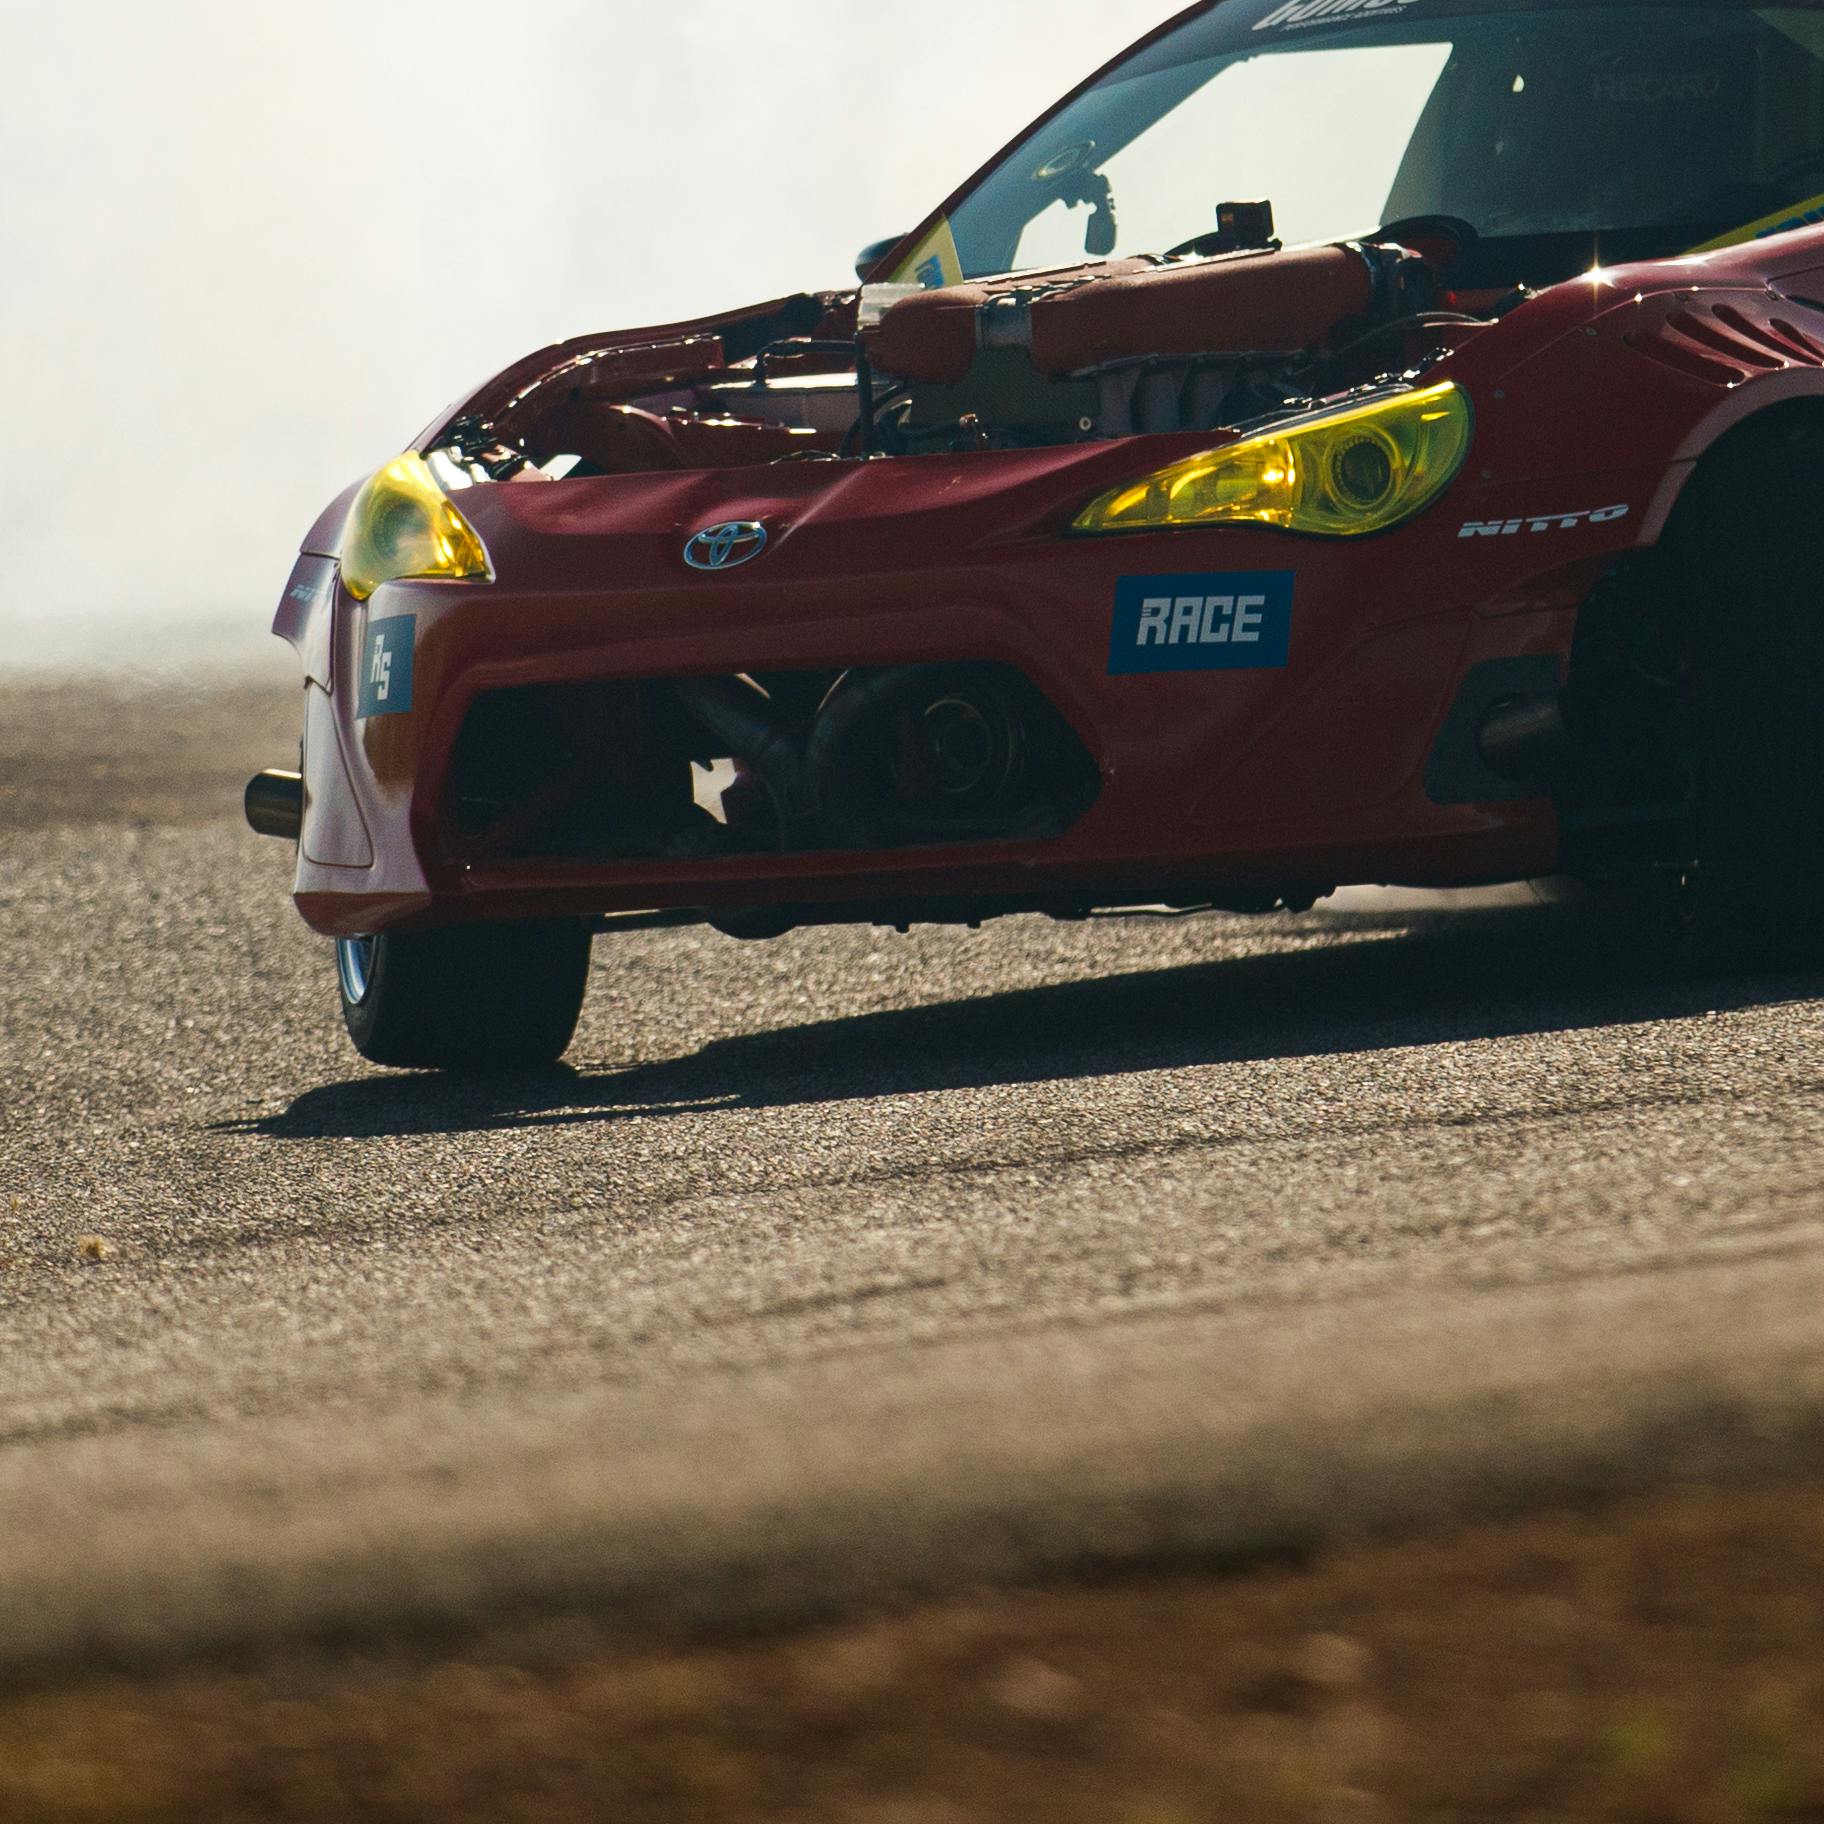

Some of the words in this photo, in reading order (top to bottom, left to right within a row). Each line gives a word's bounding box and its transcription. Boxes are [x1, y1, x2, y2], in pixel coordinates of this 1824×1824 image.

[1457, 503, 1629, 539] NITTO
[1135, 594, 1265, 646] RACE
[370, 633, 393, 702] RS
